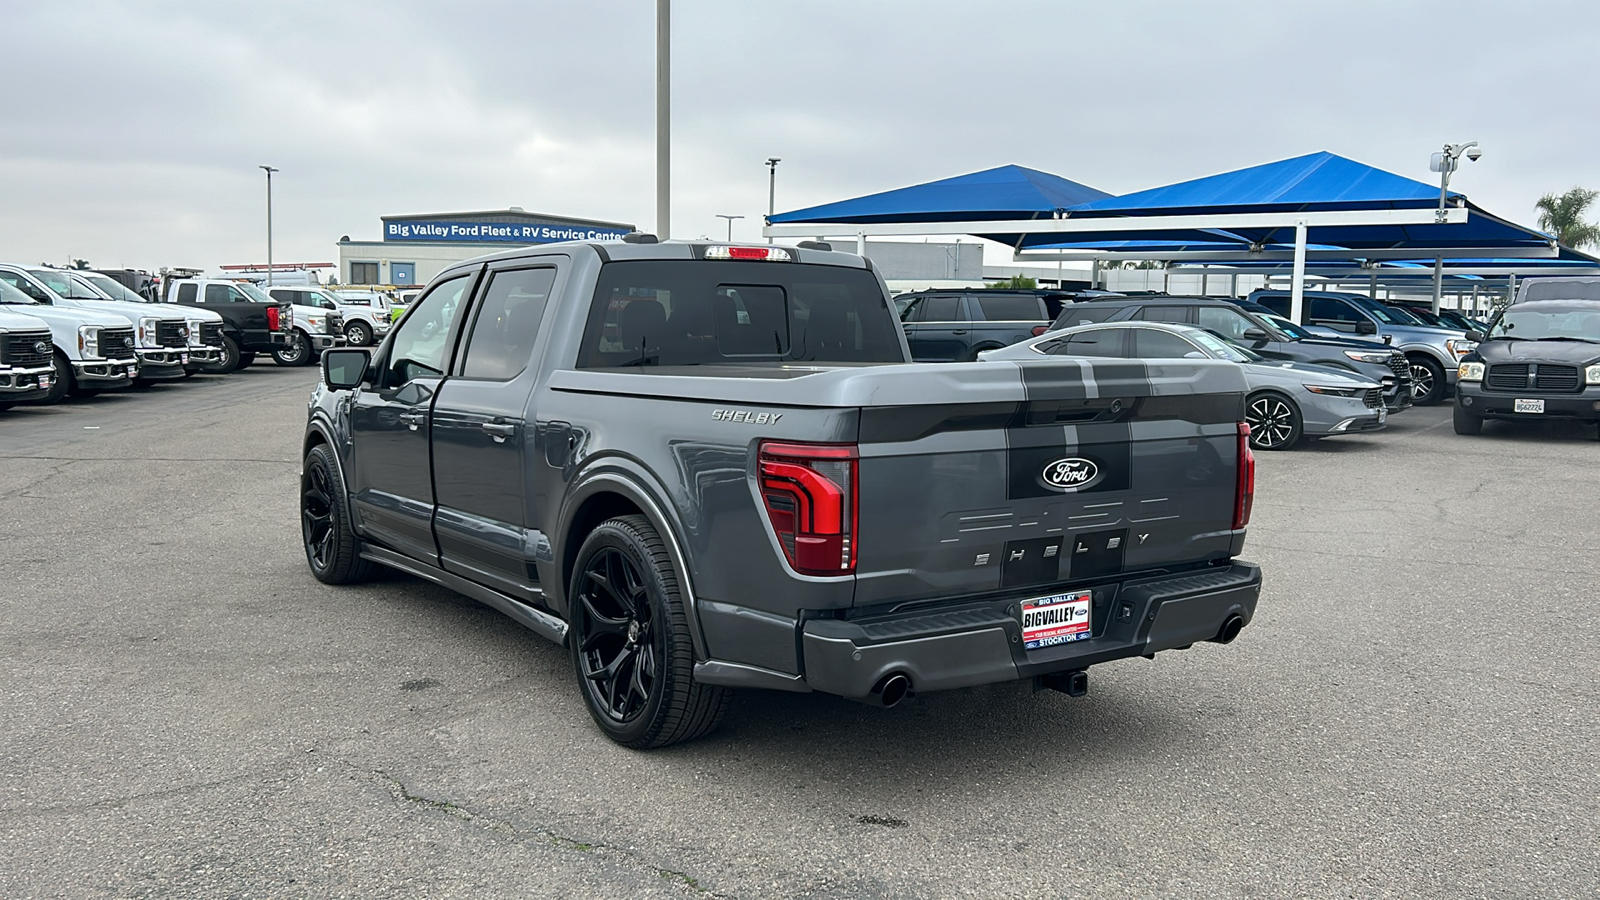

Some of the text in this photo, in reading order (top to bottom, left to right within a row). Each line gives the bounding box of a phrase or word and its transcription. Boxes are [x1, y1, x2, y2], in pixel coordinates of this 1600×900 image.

[389, 224, 409, 236] Big
[411, 224, 449, 237] Valley
[451, 225, 479, 236] Ford
[481, 225, 511, 236] Fleet
[522, 227, 539, 237] RV
[541, 228, 585, 239] Service
[711, 409, 783, 425] SHELBY
[1052, 462, 1088, 483] Ford
[974, 533, 1149, 566] SHELBY
[1052, 594, 1076, 603] VALLEY
[1024, 606, 1075, 628] BIGVALLEY
[1039, 633, 1077, 646] STOCKTON
